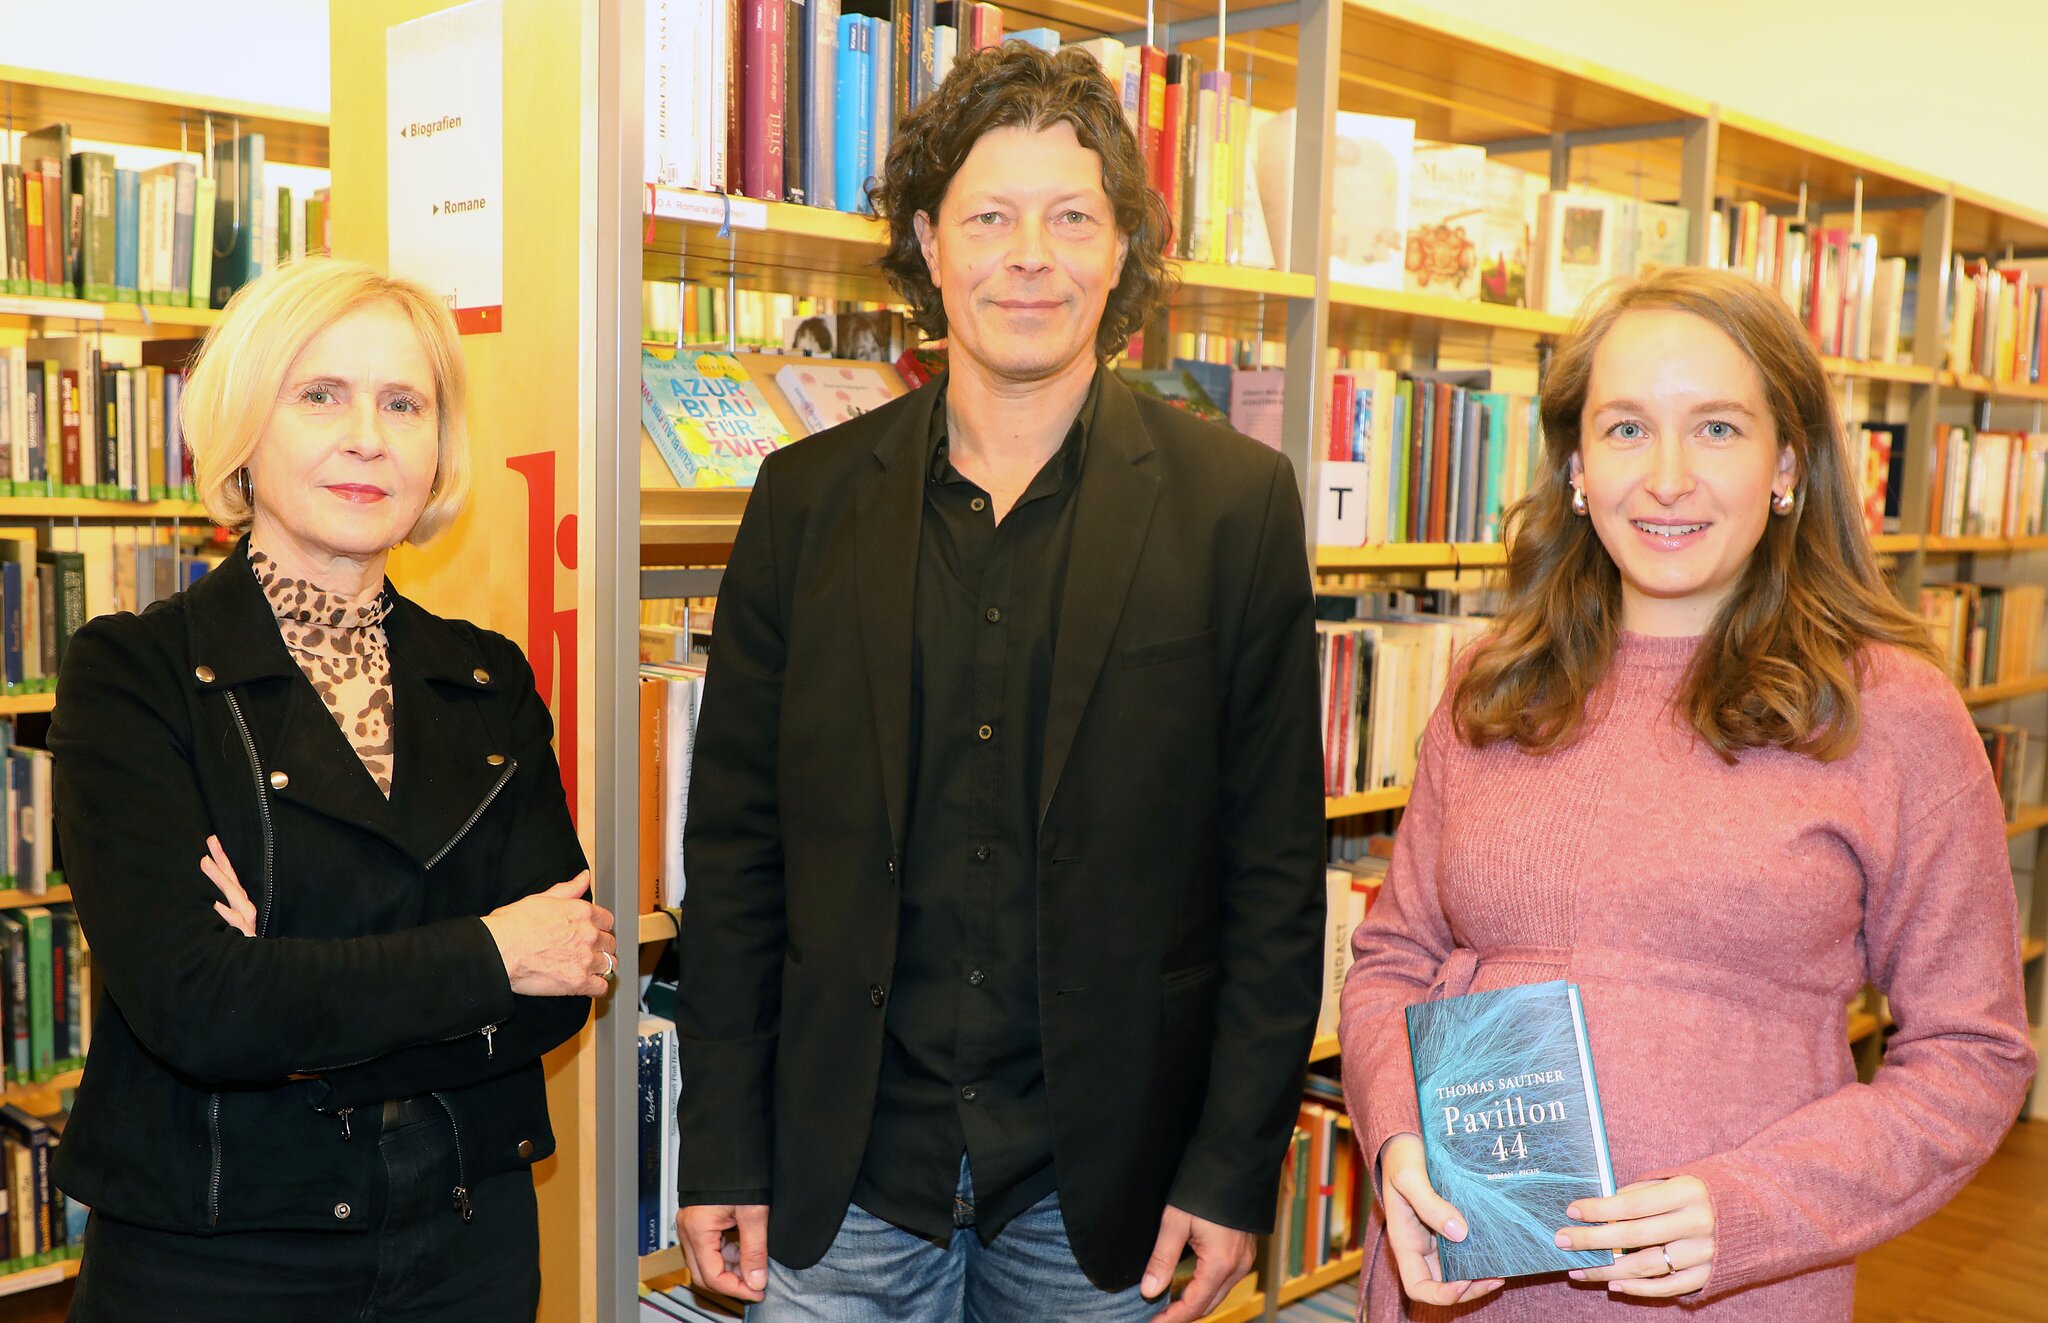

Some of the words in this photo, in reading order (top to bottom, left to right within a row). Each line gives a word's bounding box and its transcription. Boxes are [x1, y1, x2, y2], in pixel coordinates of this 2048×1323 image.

[410, 114, 462, 138] Biografien
[769, 109, 781, 156] STEEL
[1422, 162, 1476, 184] Macht
[443, 196, 486, 215] Romane
[665, 200, 672, 209] A
[676, 200, 710, 214] Romane
[670, 377, 746, 398] AZUR
[679, 398, 757, 418] BLAU
[704, 416, 756, 438] FÜR
[1329, 487, 1353, 520] T
[1436, 1080, 1495, 1100] THOMAS
[1498, 1069, 1566, 1089] SAUTNER
[1442, 1096, 1568, 1136] Pavillon
[1491, 1131, 1528, 1162] 44
[1486, 1170, 1514, 1181] ROMAN
[1518, 1167, 1540, 1177] PICUS
